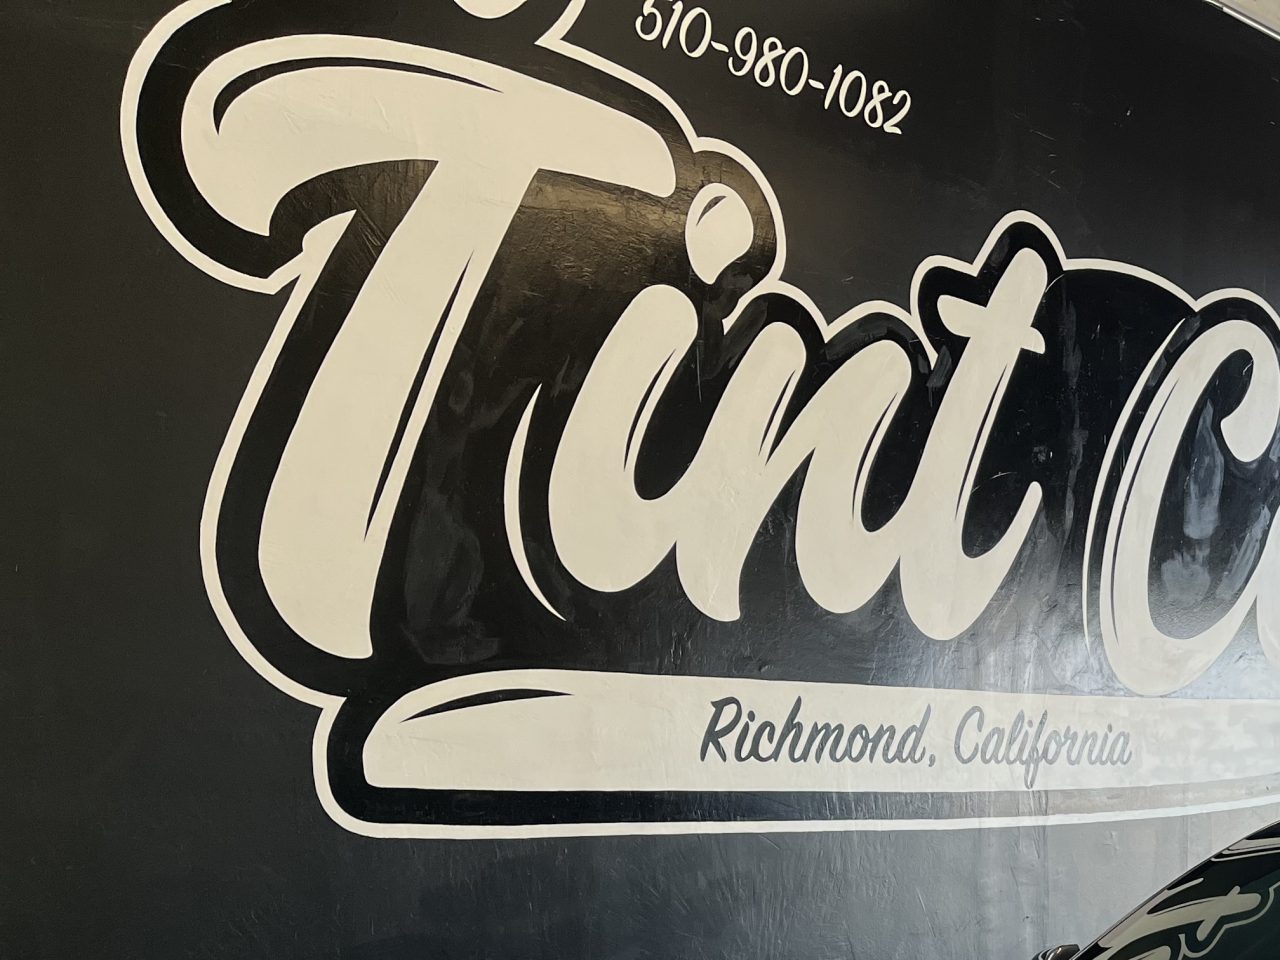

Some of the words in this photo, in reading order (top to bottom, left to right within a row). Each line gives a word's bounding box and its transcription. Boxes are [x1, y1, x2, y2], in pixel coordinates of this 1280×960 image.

[635, 0, 912, 135] 510-980-1082
[179, 66, 1046, 660] Tint
[700, 695, 937, 768] Richmond,
[953, 704, 1134, 791] California
